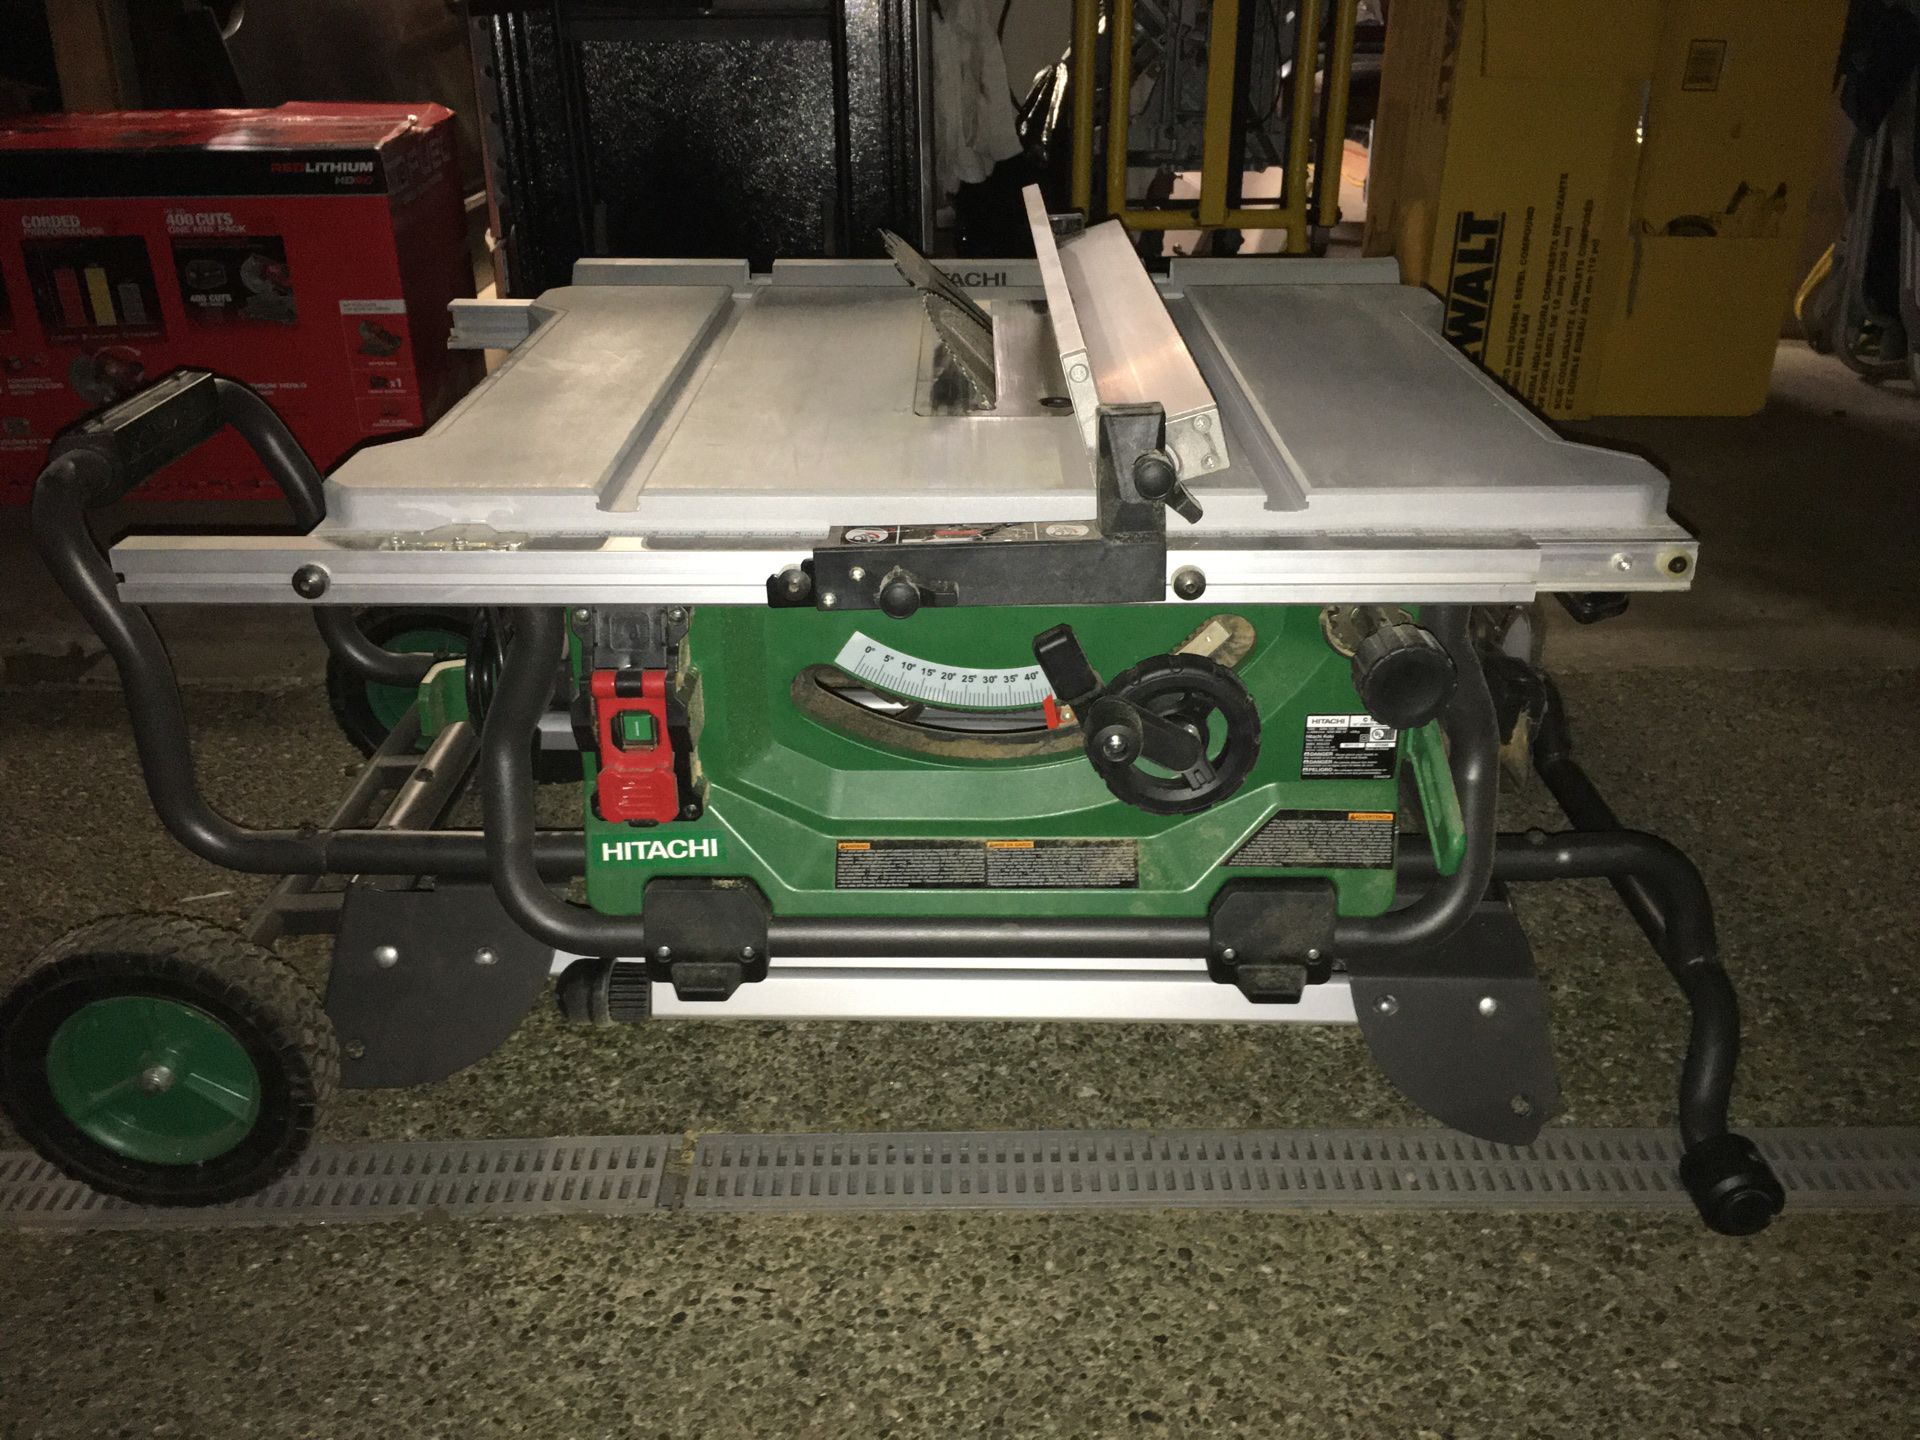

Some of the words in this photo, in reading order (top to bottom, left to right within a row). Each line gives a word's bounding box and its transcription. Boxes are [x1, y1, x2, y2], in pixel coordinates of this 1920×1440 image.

[21, 214, 81, 228] CORDED
[196, 212, 234, 226] CUTS
[1446, 211, 1499, 357] WALT
[865, 645, 876, 654] 0°
[884, 654, 894, 663] 5°
[901, 661, 917, 671] 10°
[921, 667, 937, 677] 15°
[941, 671, 957, 681] 20°
[961, 673, 977, 683] 25°
[982, 675, 998, 684] 30°
[1003, 674, 1018, 683] 35°
[1024, 671, 1039, 681] 40°
[602, 838, 718, 861] HITACHI
